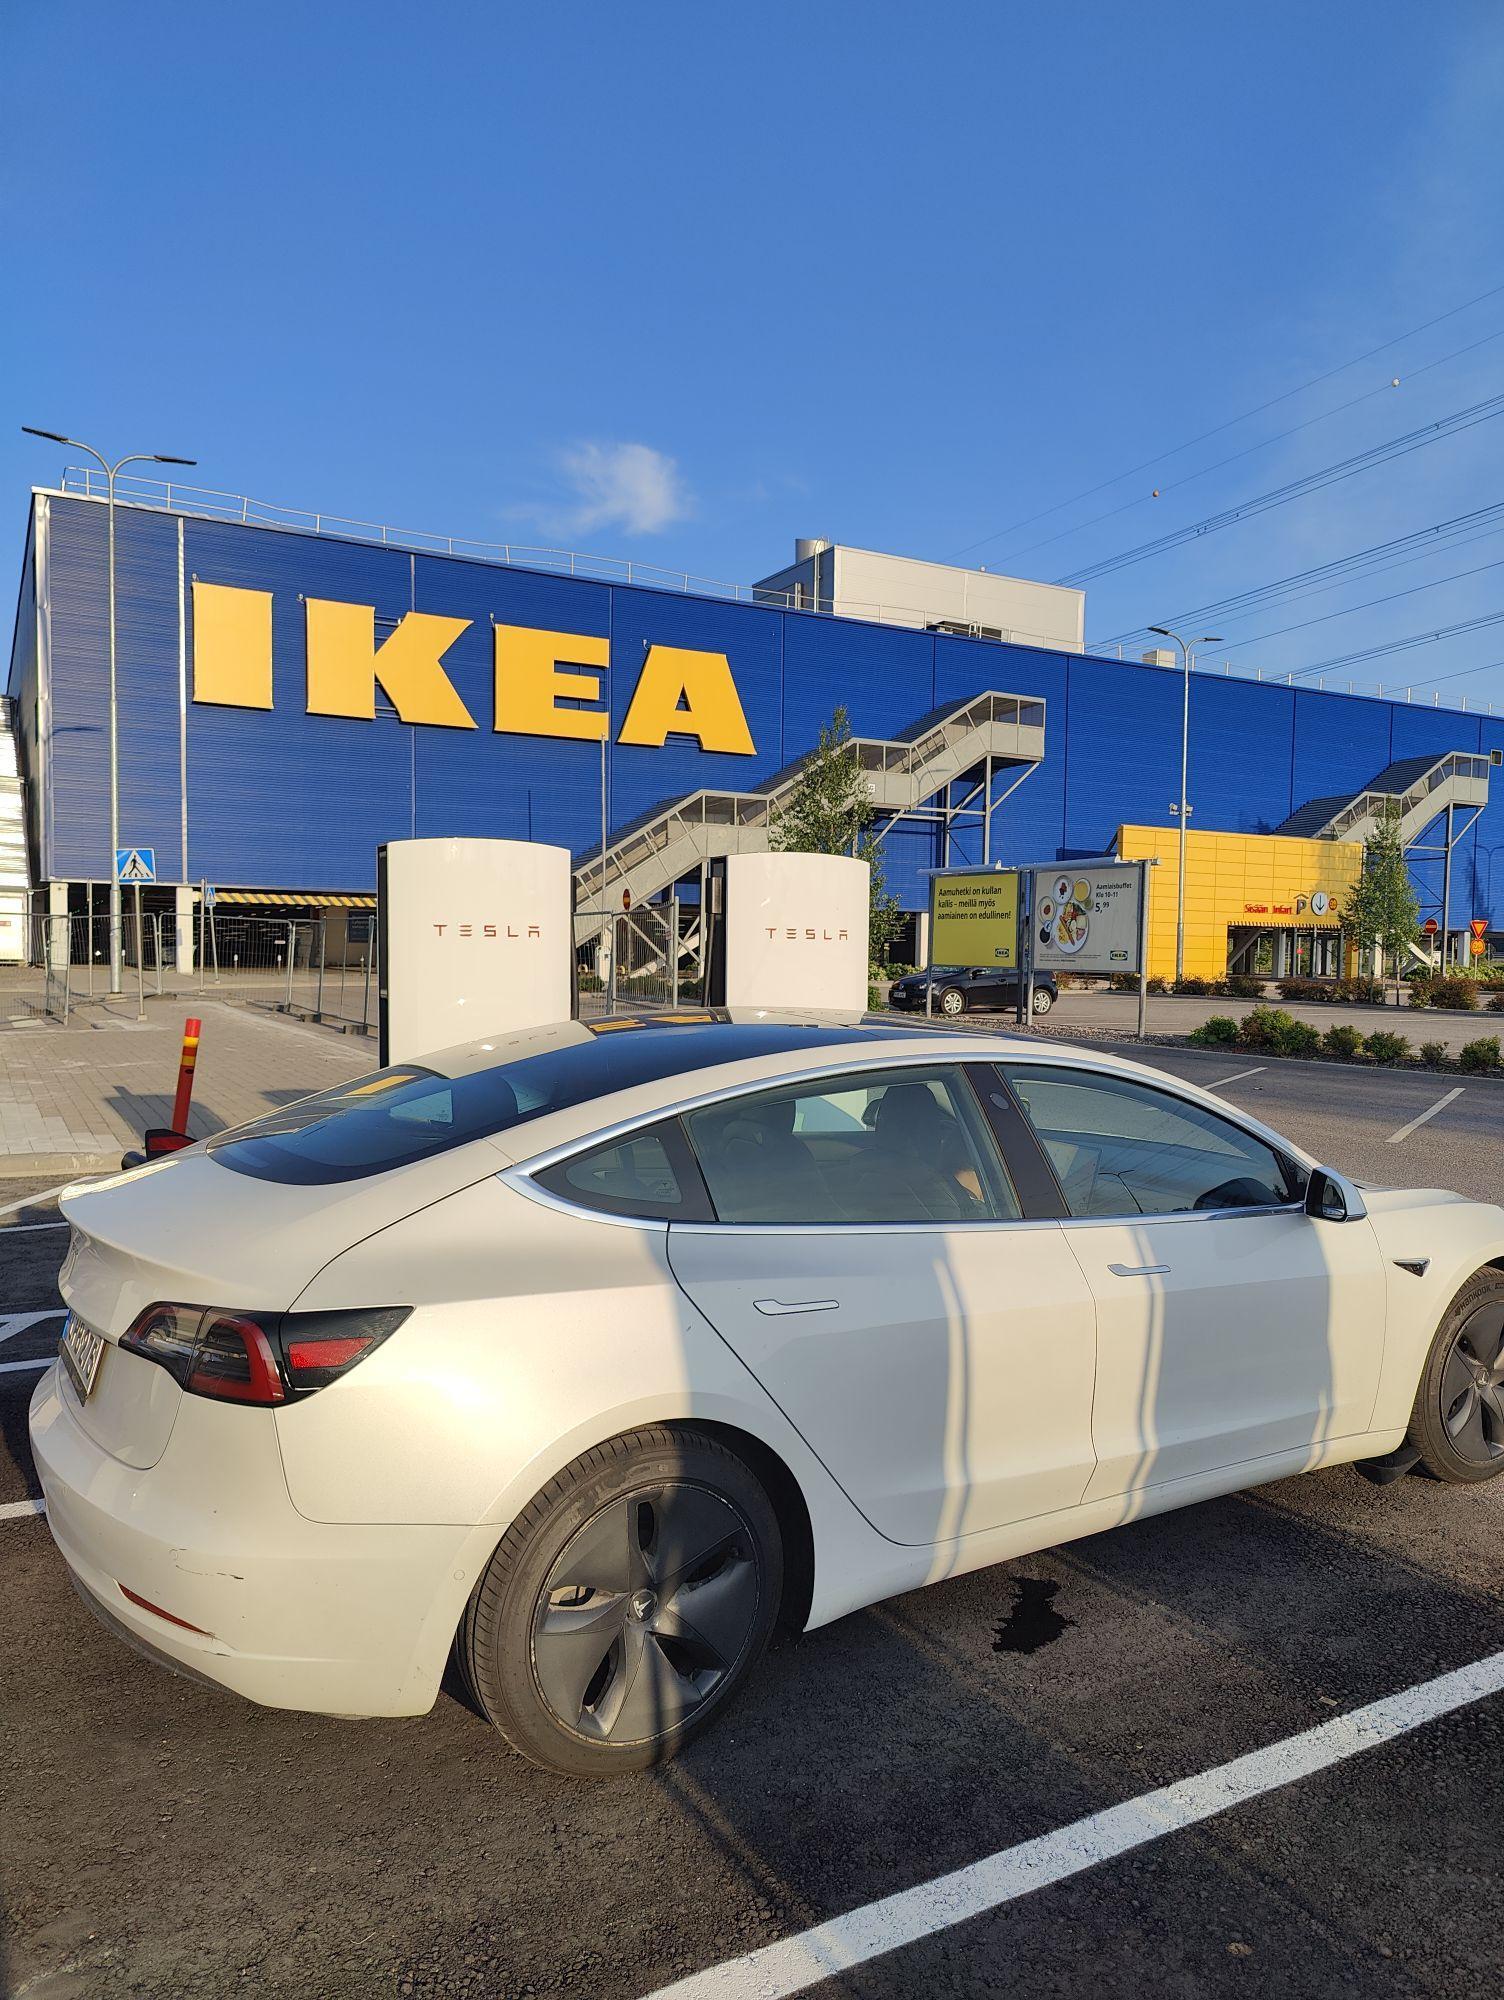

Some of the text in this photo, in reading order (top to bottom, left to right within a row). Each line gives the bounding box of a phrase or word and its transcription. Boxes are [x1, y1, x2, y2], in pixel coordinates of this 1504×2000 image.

[192, 582, 757, 755] IKEA
[939, 887, 971, 896] Aamuhetki
[981, 886, 1002, 895] kullan
[938, 900, 953, 908] kallis
[959, 899, 977, 908] meillä
[978, 899, 996, 909] myös
[938, 912, 968, 920] aamiainen
[978, 911, 1011, 920] edullinen!
[433, 924, 540, 938] TESLA
[765, 927, 848, 940] TESLA
